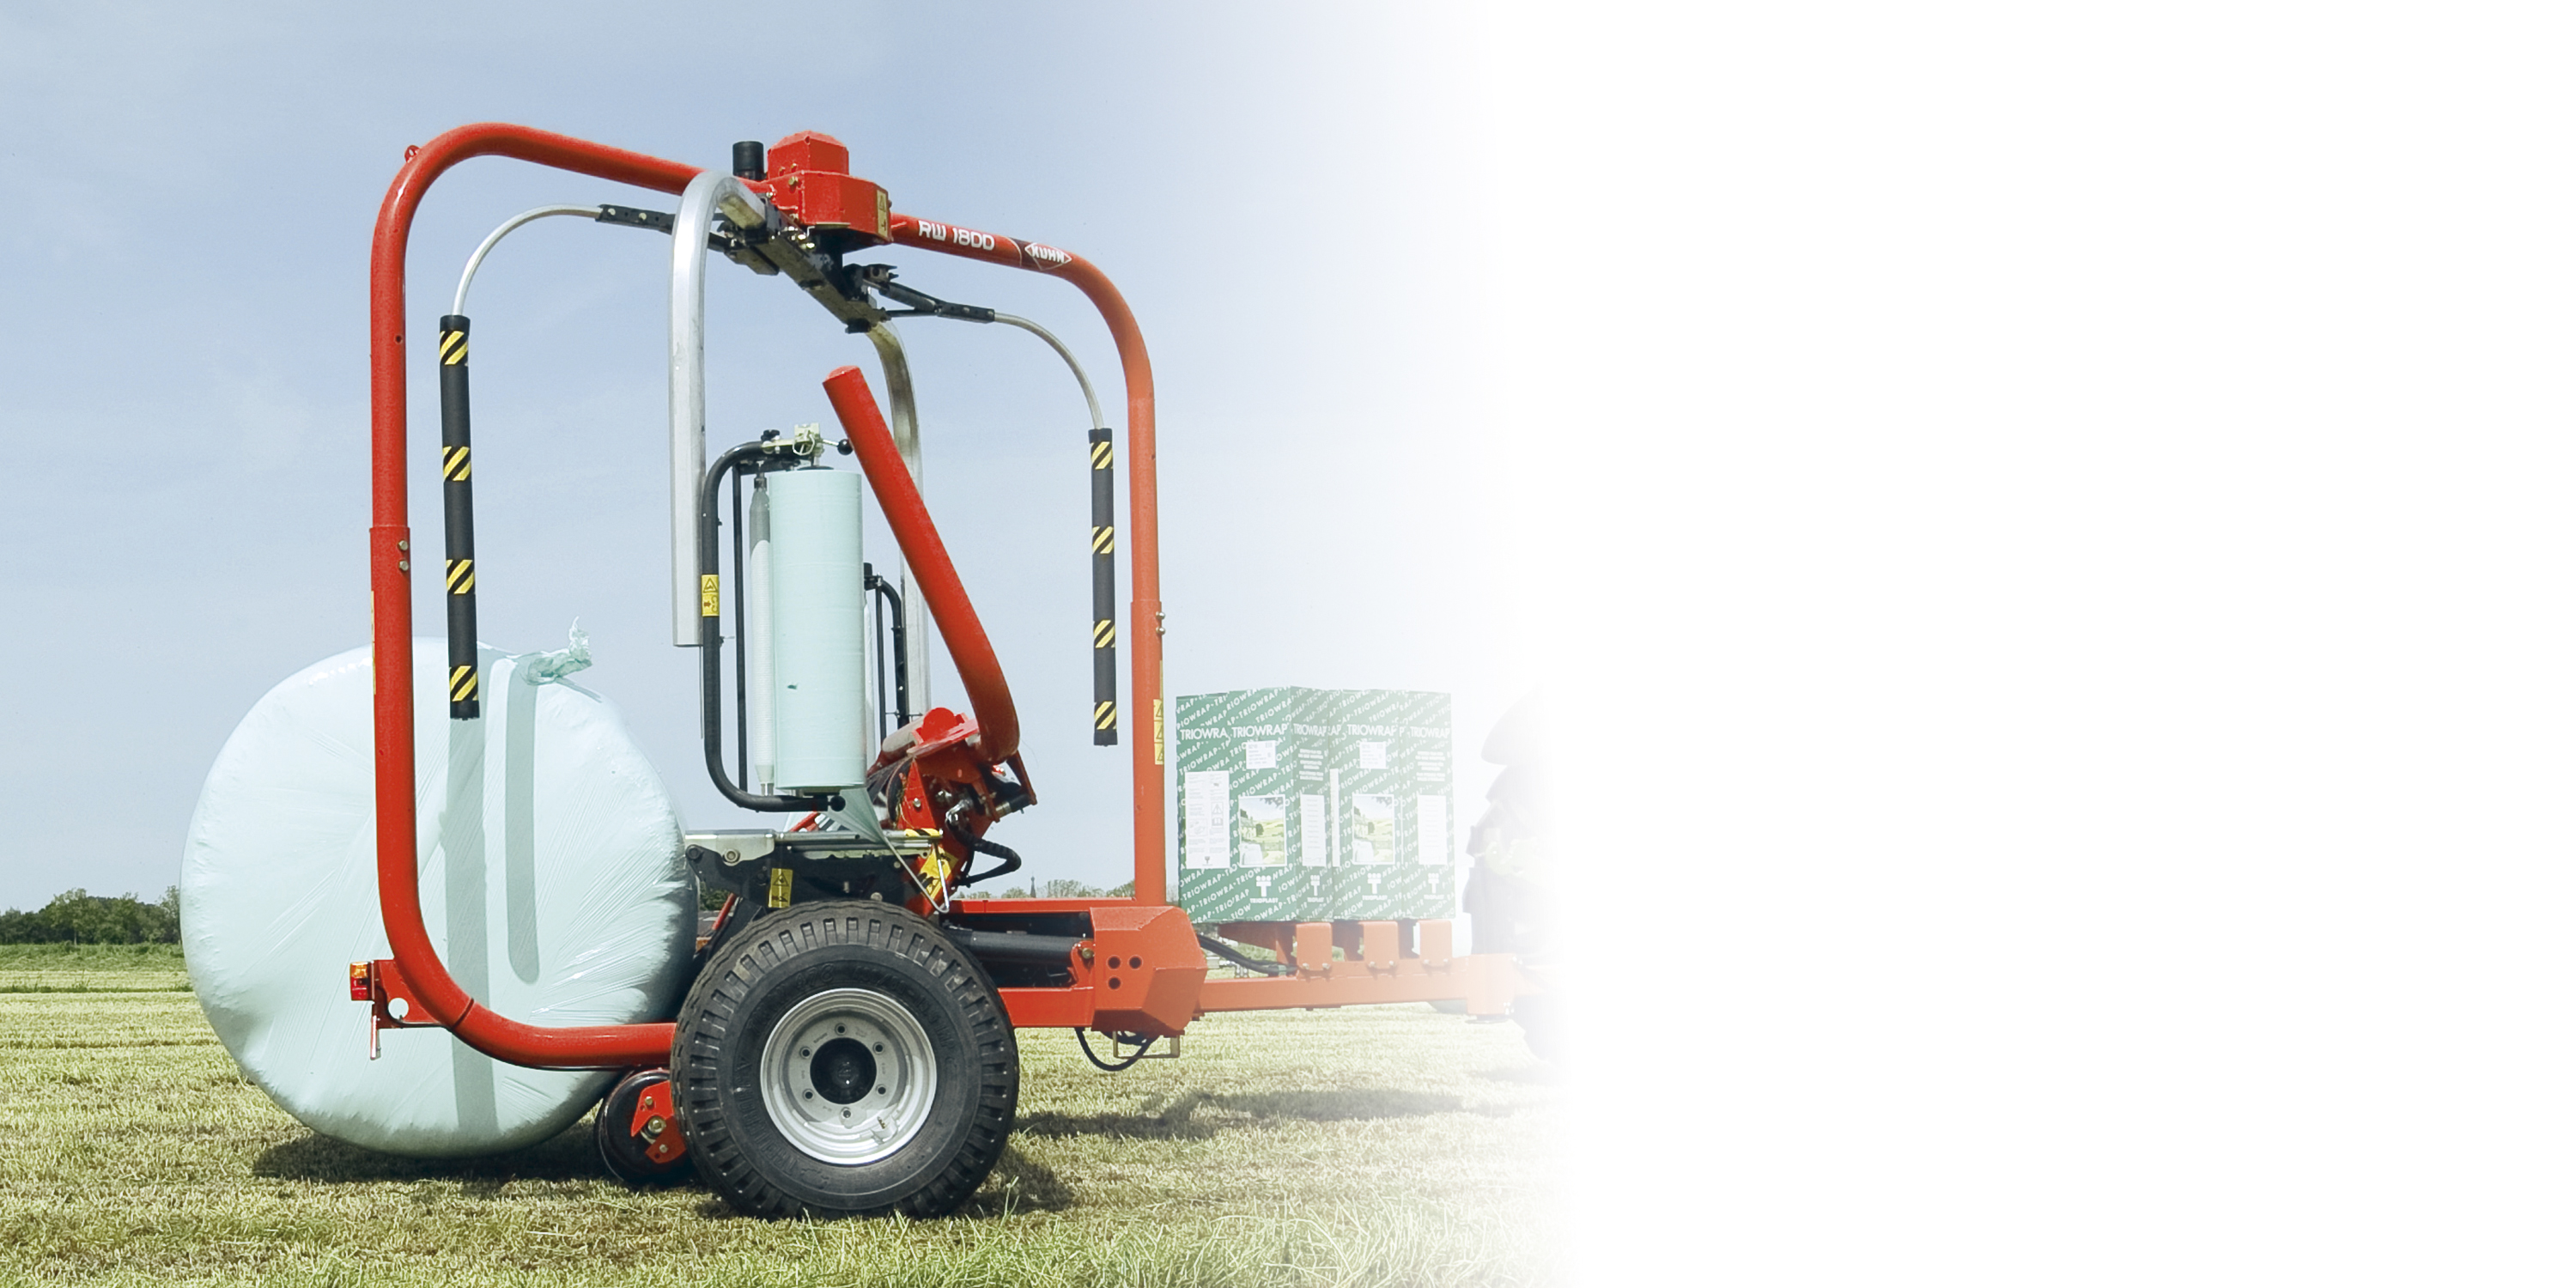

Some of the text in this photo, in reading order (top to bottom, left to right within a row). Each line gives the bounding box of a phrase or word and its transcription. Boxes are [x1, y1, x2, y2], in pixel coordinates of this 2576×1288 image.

[918, 220, 995, 251] RW 1800
[1030, 244, 1065, 264] KUHN
[1231, 723, 1288, 738] TRIOWRAP
[1293, 723, 1327, 738] TRIOWRAP
[1346, 723, 1396, 737] TRIOWRAP
[1410, 726, 1451, 738] TRIOWRAP
